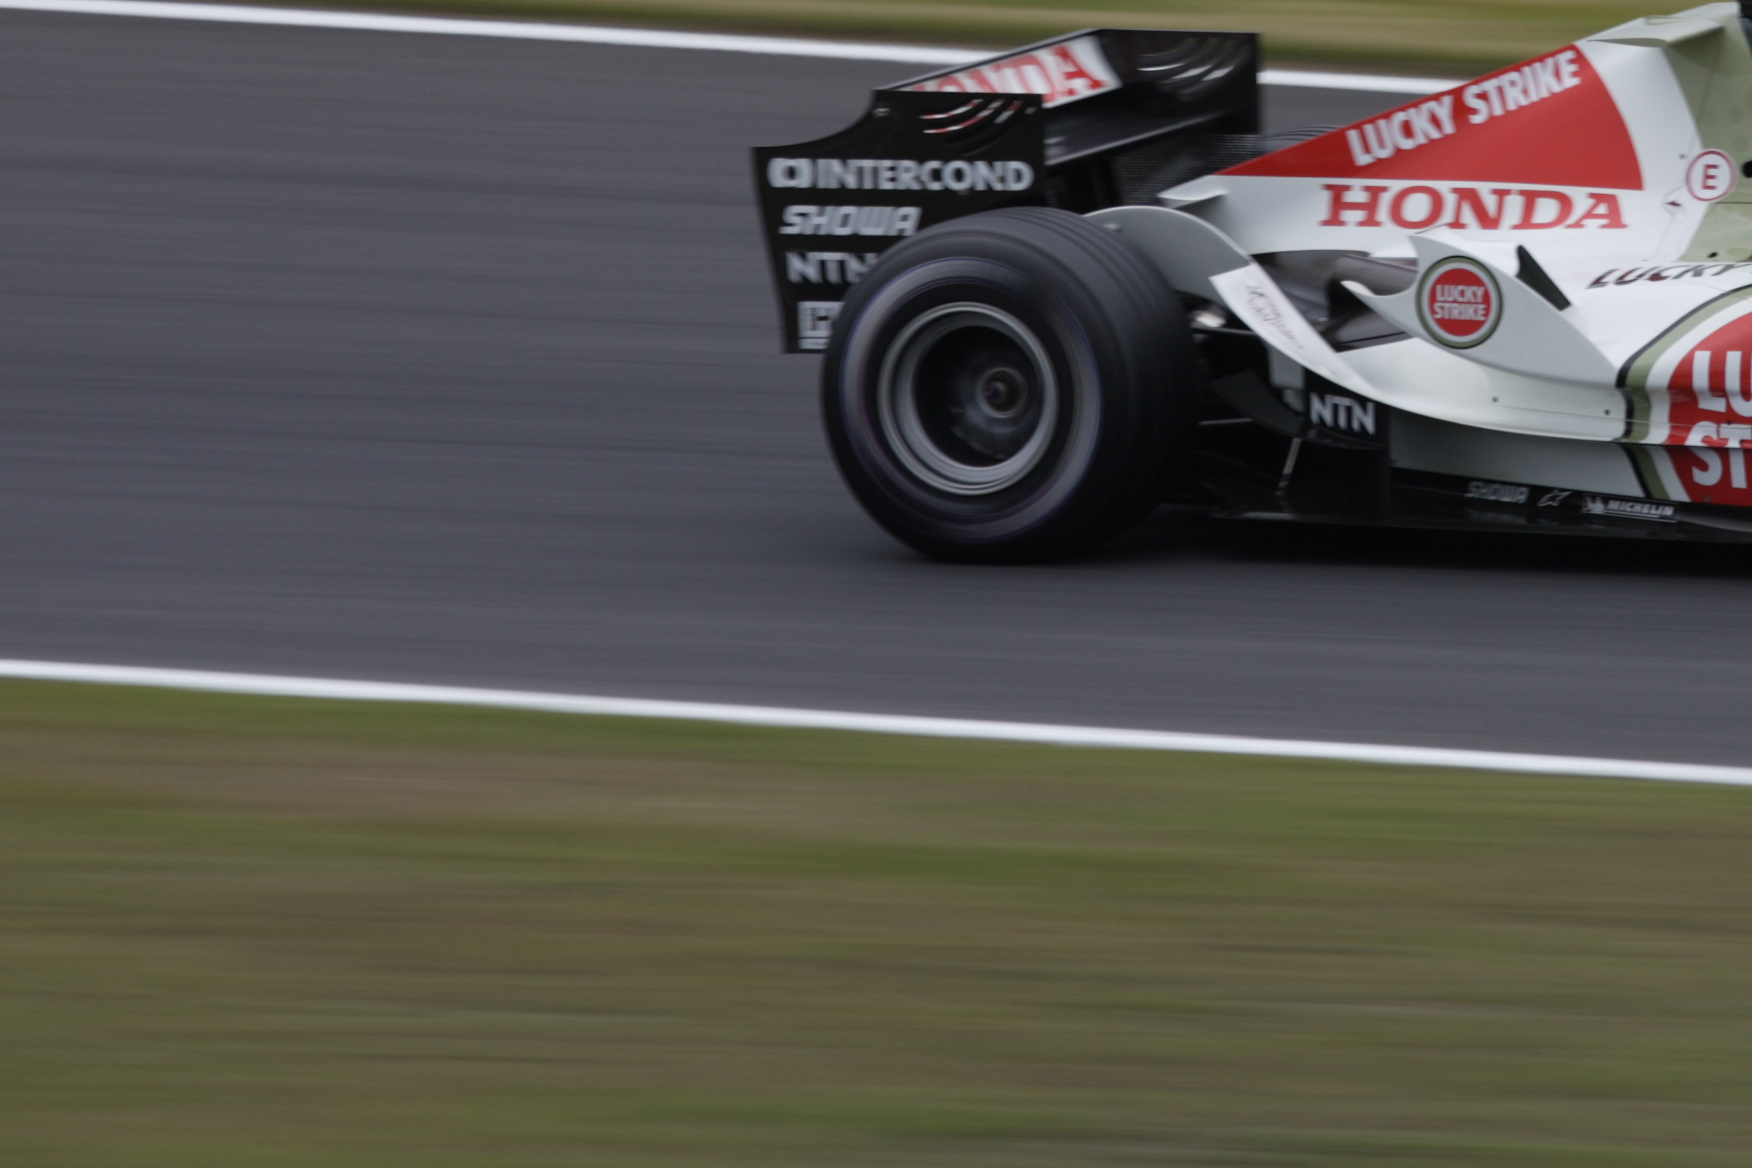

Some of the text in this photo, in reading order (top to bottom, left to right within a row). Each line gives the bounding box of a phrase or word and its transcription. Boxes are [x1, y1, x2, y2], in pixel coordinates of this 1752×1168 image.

[1345, 50, 1581, 166] LUCKY STRIKE
[815, 159, 1035, 191] INTERCOND
[1702, 163, 1719, 189] E
[779, 205, 922, 236] SHOWA
[1320, 183, 1628, 230] HONDA
[1435, 284, 1485, 304] LUCKY
[1432, 302, 1487, 322] STRIKE
[1310, 391, 1375, 435] NTN
[1464, 481, 1530, 504] SHOWA
[1606, 499, 1675, 517] MICHELIN
